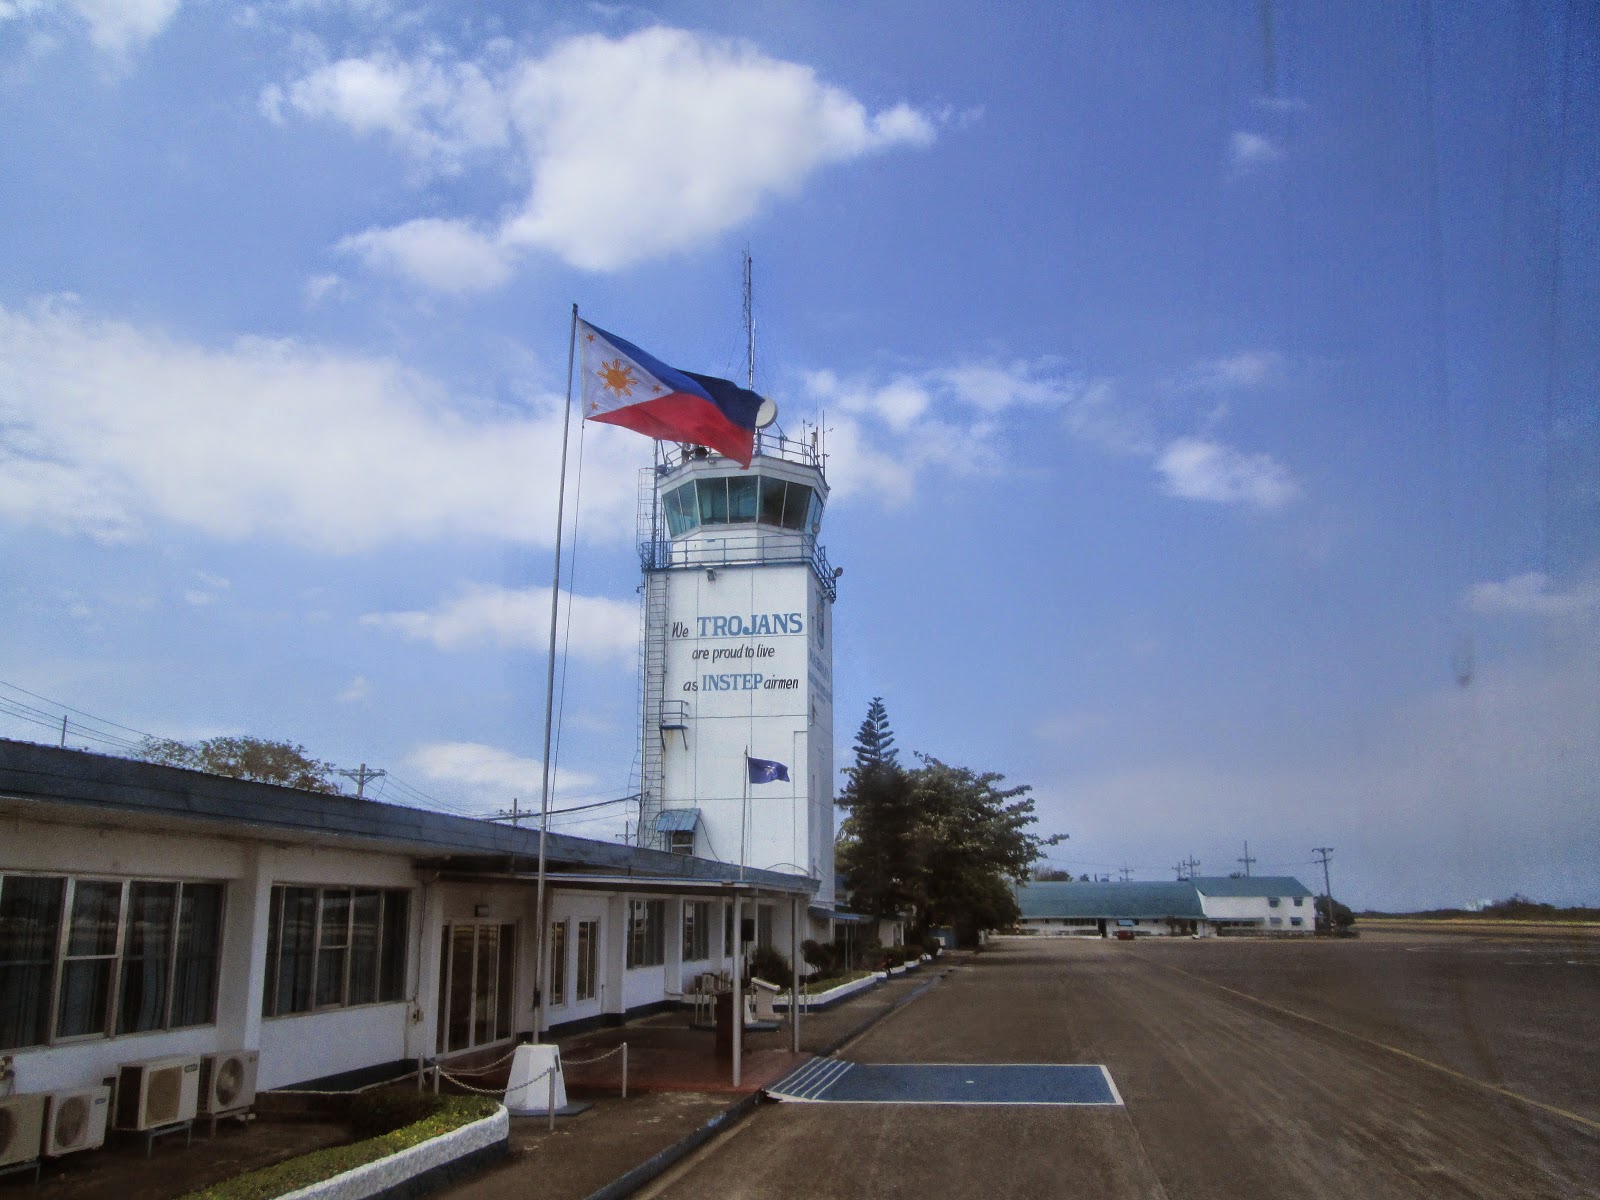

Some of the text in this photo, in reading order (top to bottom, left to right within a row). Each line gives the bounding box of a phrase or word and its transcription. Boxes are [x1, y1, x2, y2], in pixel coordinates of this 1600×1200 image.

[672, 613, 803, 638] We TROJANS
[692, 644, 775, 664] are proud to live
[683, 681, 698, 692] as
[702, 673, 763, 692] INSTEP
[763, 675, 799, 690] airmen
